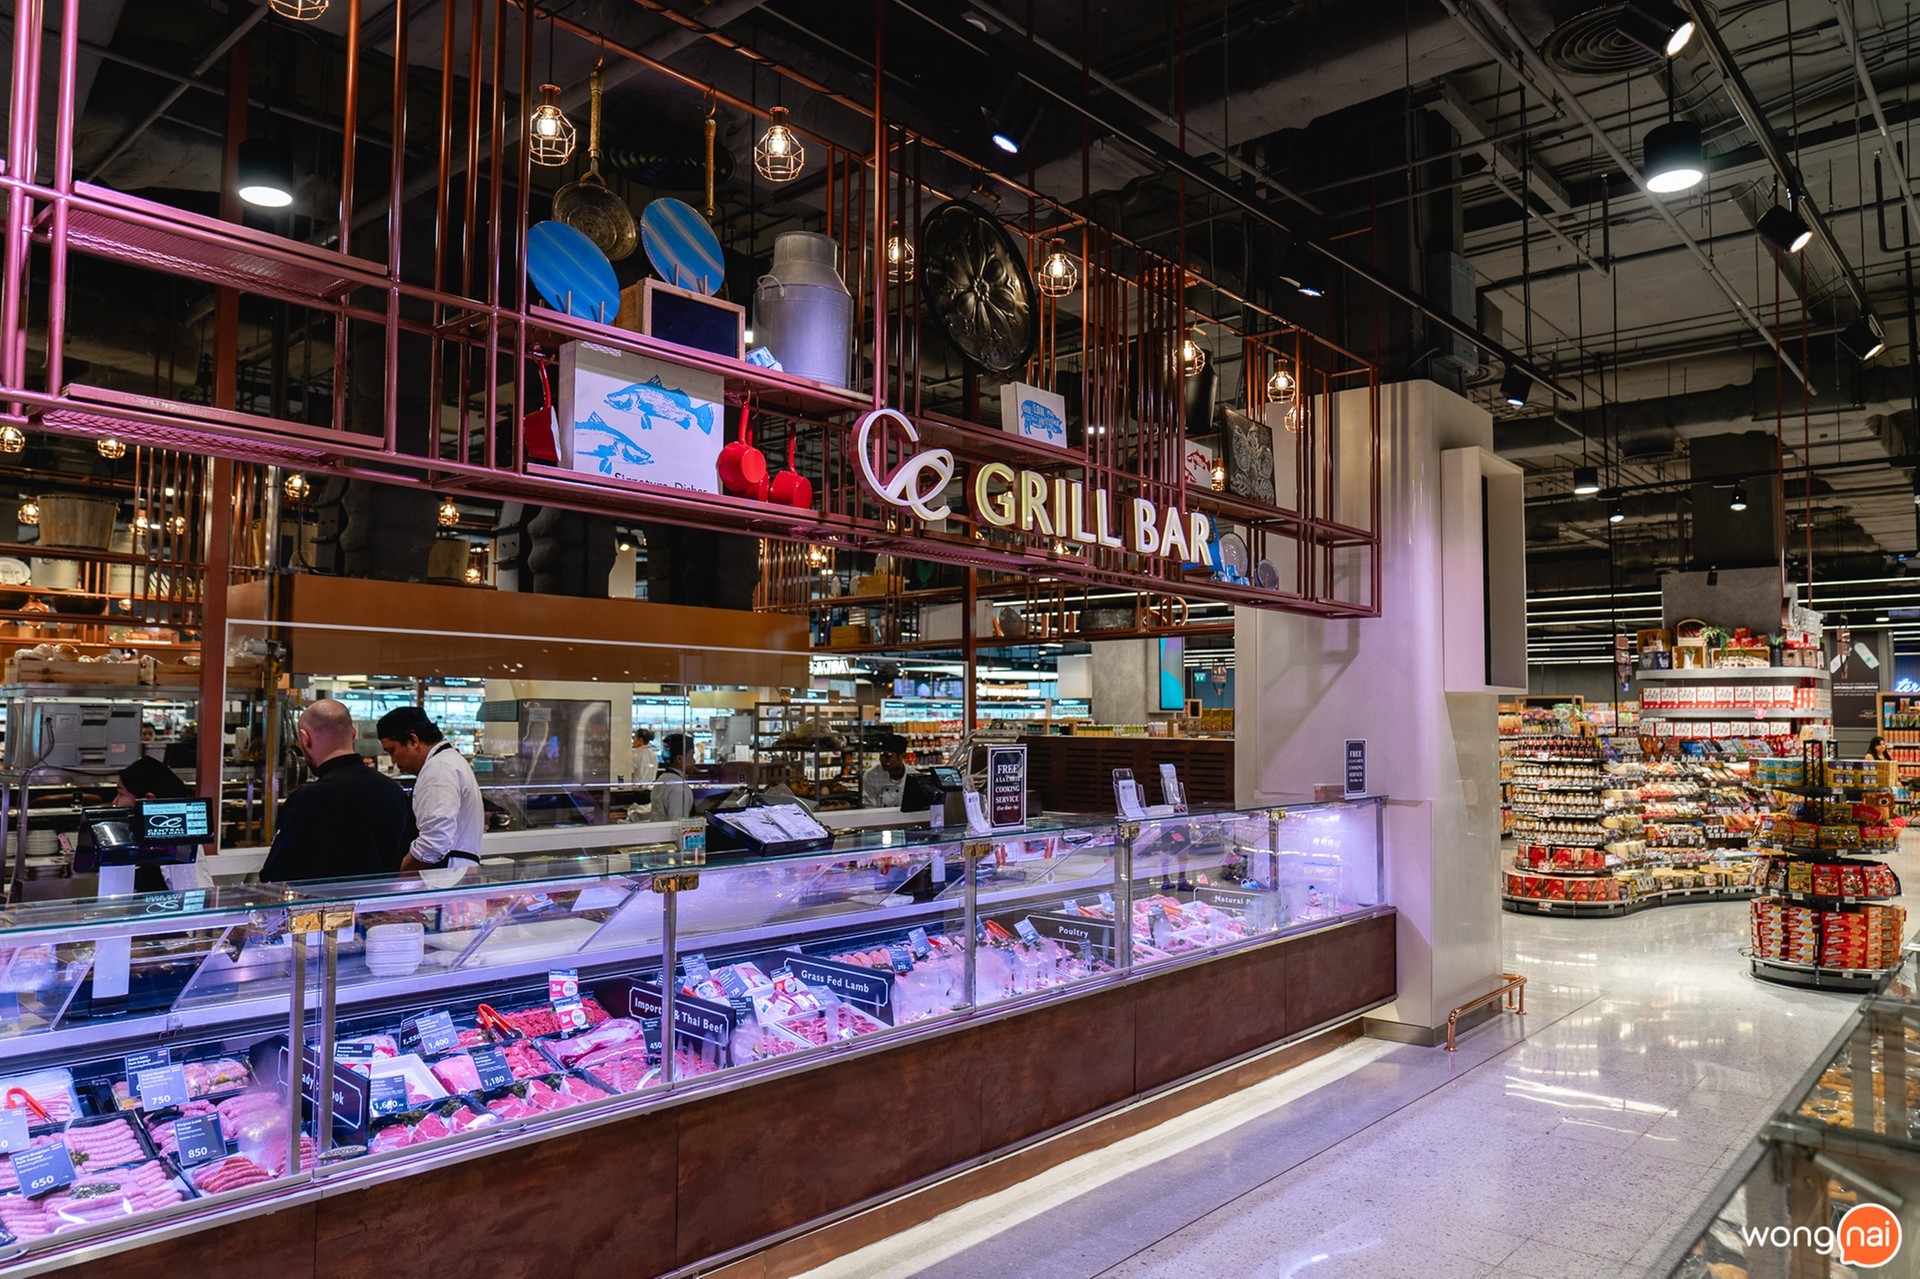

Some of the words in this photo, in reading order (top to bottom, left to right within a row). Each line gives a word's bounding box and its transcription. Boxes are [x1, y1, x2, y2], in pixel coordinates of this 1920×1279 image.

[975, 462, 1122, 548] GRILL
[1133, 497, 1214, 566] BAR
[1349, 750, 1362, 758] FREE
[997, 764, 1019, 774] FREE
[995, 785, 1020, 793] COOKING
[995, 795, 1019, 803] SERVICE
[1214, 895, 1244, 905] Natural
[1058, 926, 1089, 939] Poultry
[801, 969, 825, 983] Grass
[827, 975, 842, 987] Fed
[845, 979, 869, 993] Lamb
[634, 997, 663, 1015] Import
[674, 1010, 680, 1020] &
[682, 1011, 701, 1027] Thai
[703, 1019, 723, 1033] Beef
[428, 1037, 449, 1049] 1,400
[484, 1075, 505, 1086] 1,180
[151, 1095, 170, 1105] 750
[188, 1146, 207, 1158] 850
[31, 1175, 55, 1189] 650
